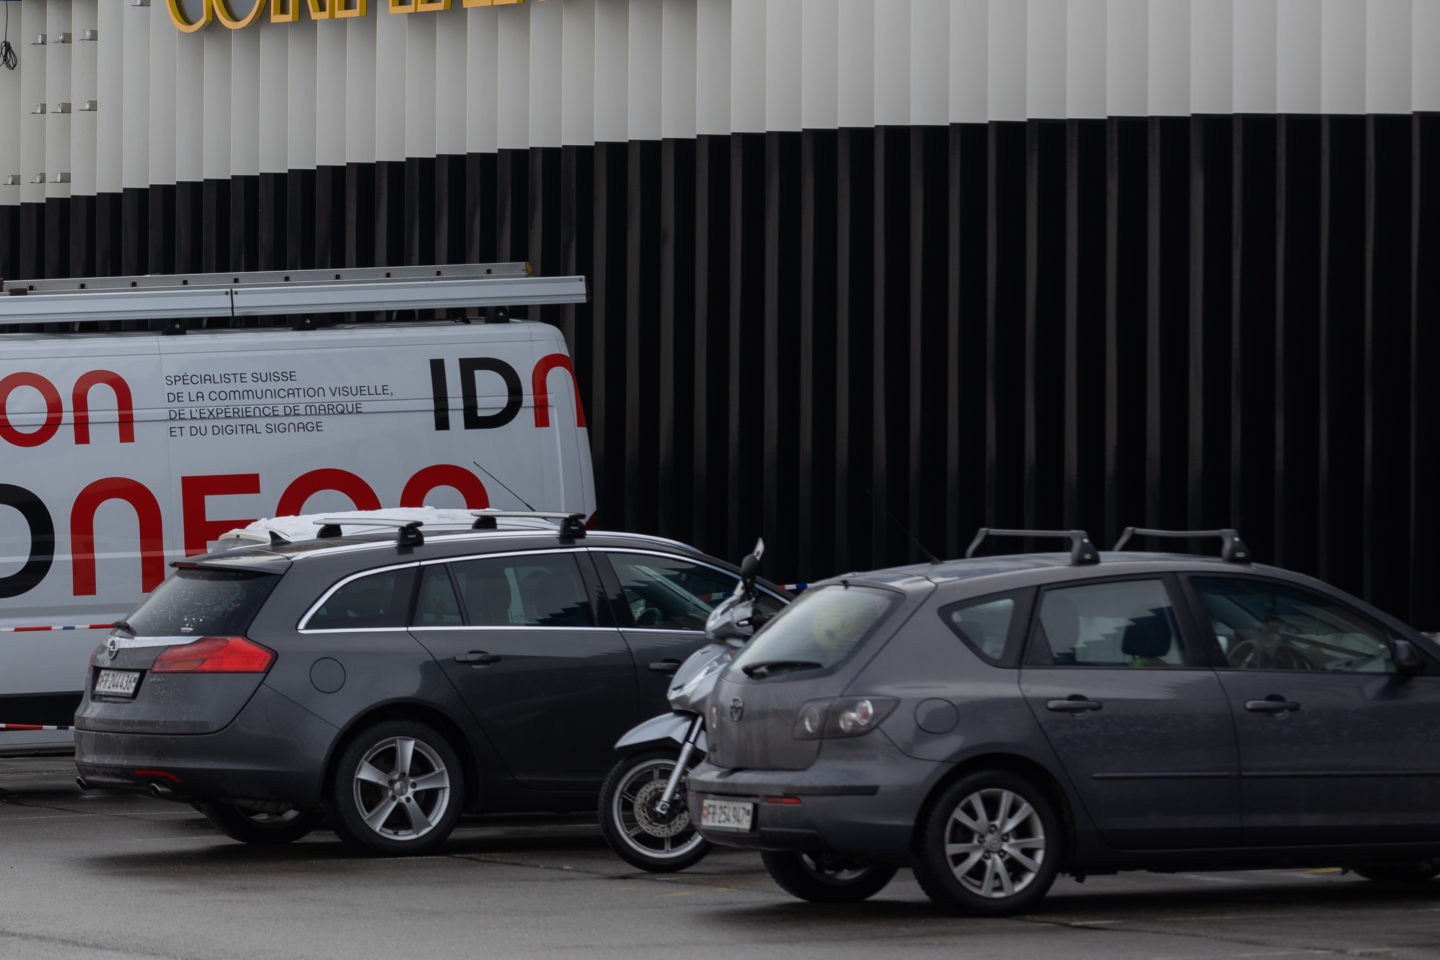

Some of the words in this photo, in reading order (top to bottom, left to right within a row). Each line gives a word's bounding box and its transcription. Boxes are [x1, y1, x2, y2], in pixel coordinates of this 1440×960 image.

[165, 372, 248, 386] SPÉCIALISTE
[251, 370, 297, 383] SUISSE
[167, 392, 184, 403] DE
[188, 391, 205, 402] LA
[208, 386, 326, 402] COMMUNICATION
[328, 384, 394, 398] VISUELLE,
[168, 409, 186, 420] DE
[189, 405, 280, 420] L'EXPÉRIENCE
[283, 405, 301, 417] DE
[304, 402, 363, 416] MARQUE
[169, 426, 185, 437] ET
[189, 425, 207, 437] DU
[211, 423, 262, 436] DIGITAL
[265, 421, 324, 434] SIGNAGE
